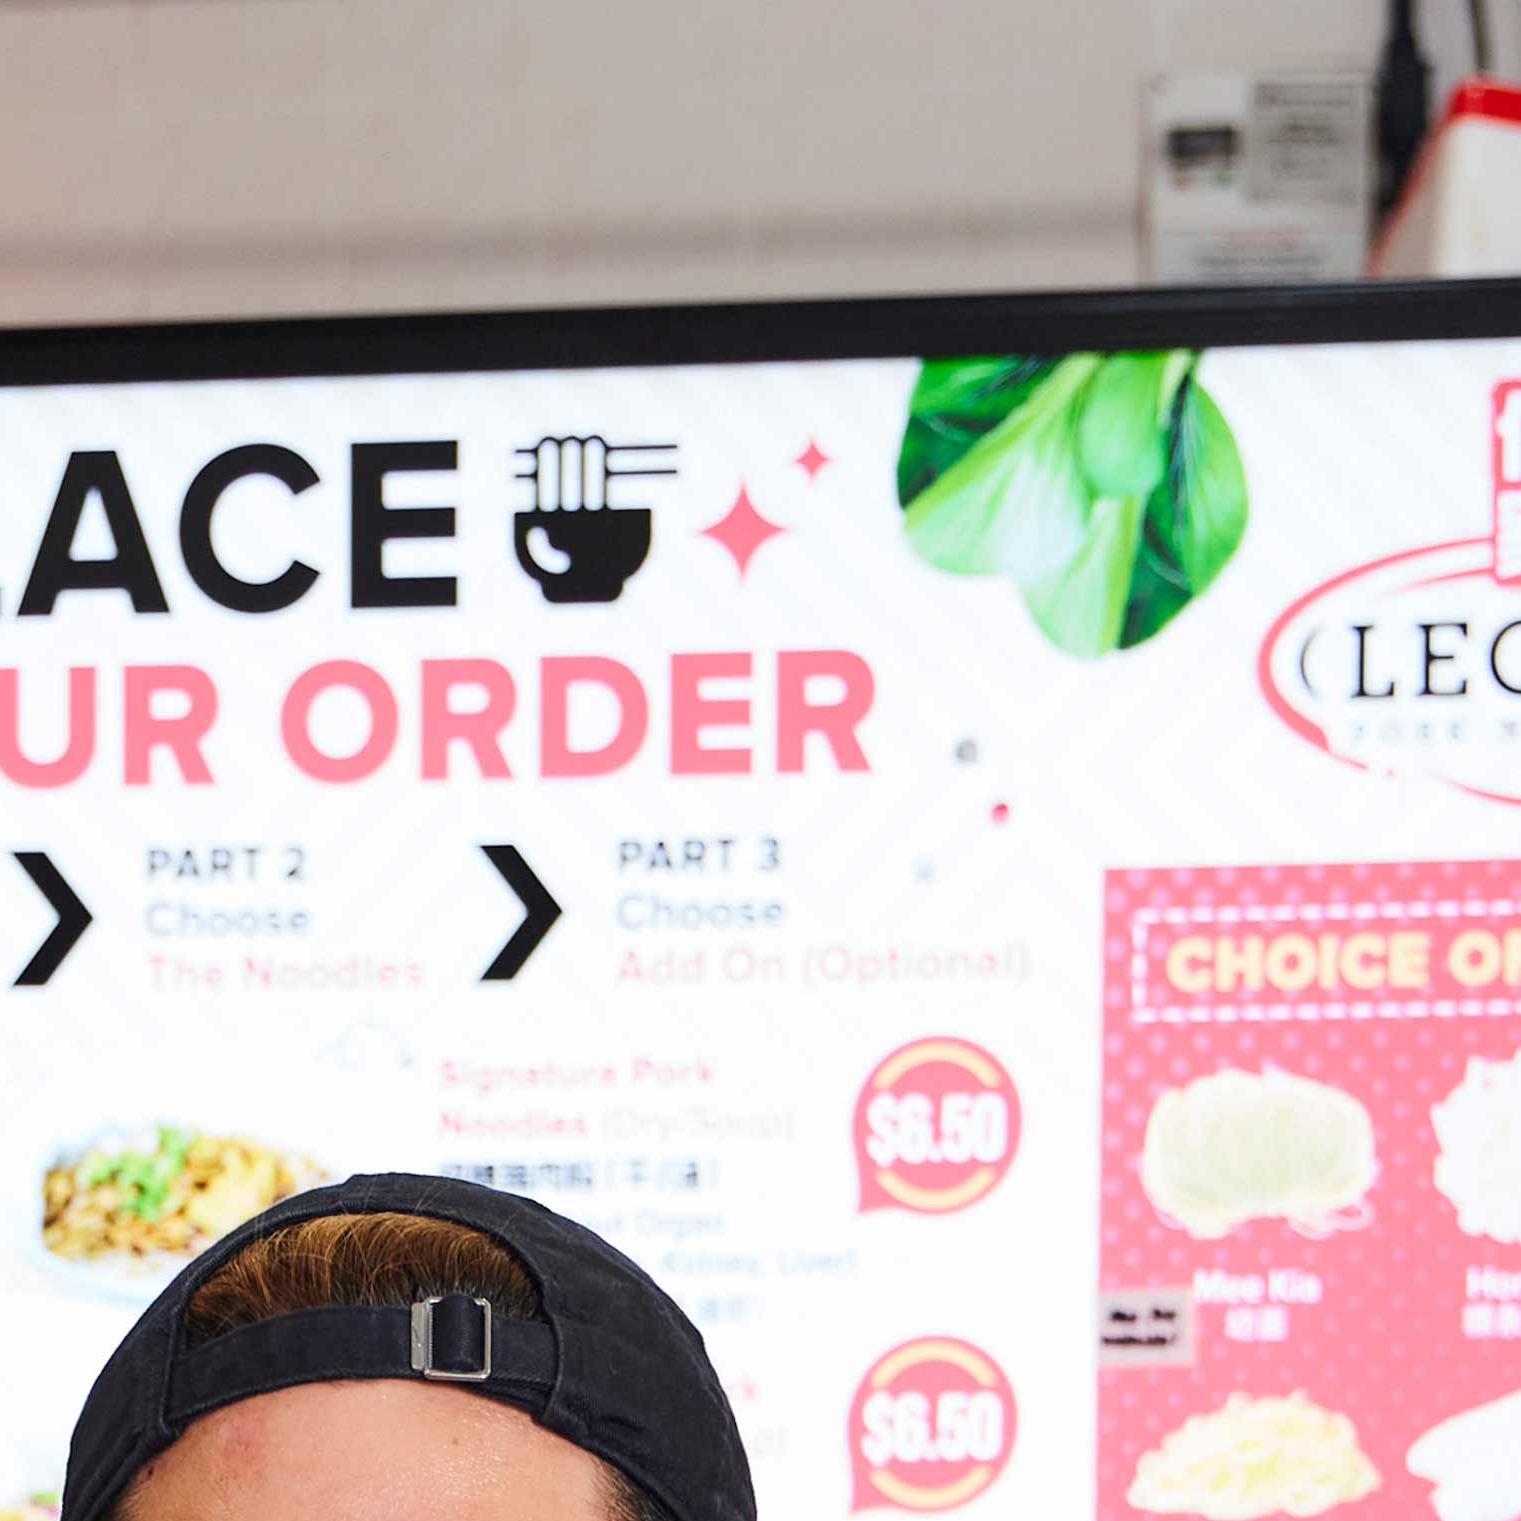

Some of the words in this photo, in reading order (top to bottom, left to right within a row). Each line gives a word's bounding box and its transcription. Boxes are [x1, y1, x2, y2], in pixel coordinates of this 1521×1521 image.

[280, 649, 877, 784] ORDER
[147, 848, 260, 881] PART
[284, 846, 306, 880] 2
[619, 839, 736, 874] PART
[759, 838, 782, 871] 3
[145, 902, 311, 938] Choose
[616, 895, 786, 933] Choose
[147, 955, 225, 991] The
[241, 953, 425, 992] Noodles
[618, 949, 705, 985] Add
[722, 948, 781, 984] On
[802, 942, 1032, 988] (Optional)
[1166, 931, 1429, 992] CHOICE
[438, 1059, 617, 1094] Signature
[630, 1056, 715, 1084] Pork
[438, 1110, 588, 1137] Noodles
[866, 1092, 1006, 1166] $6.50
[861, 1391, 1003, 1467] $6.50
